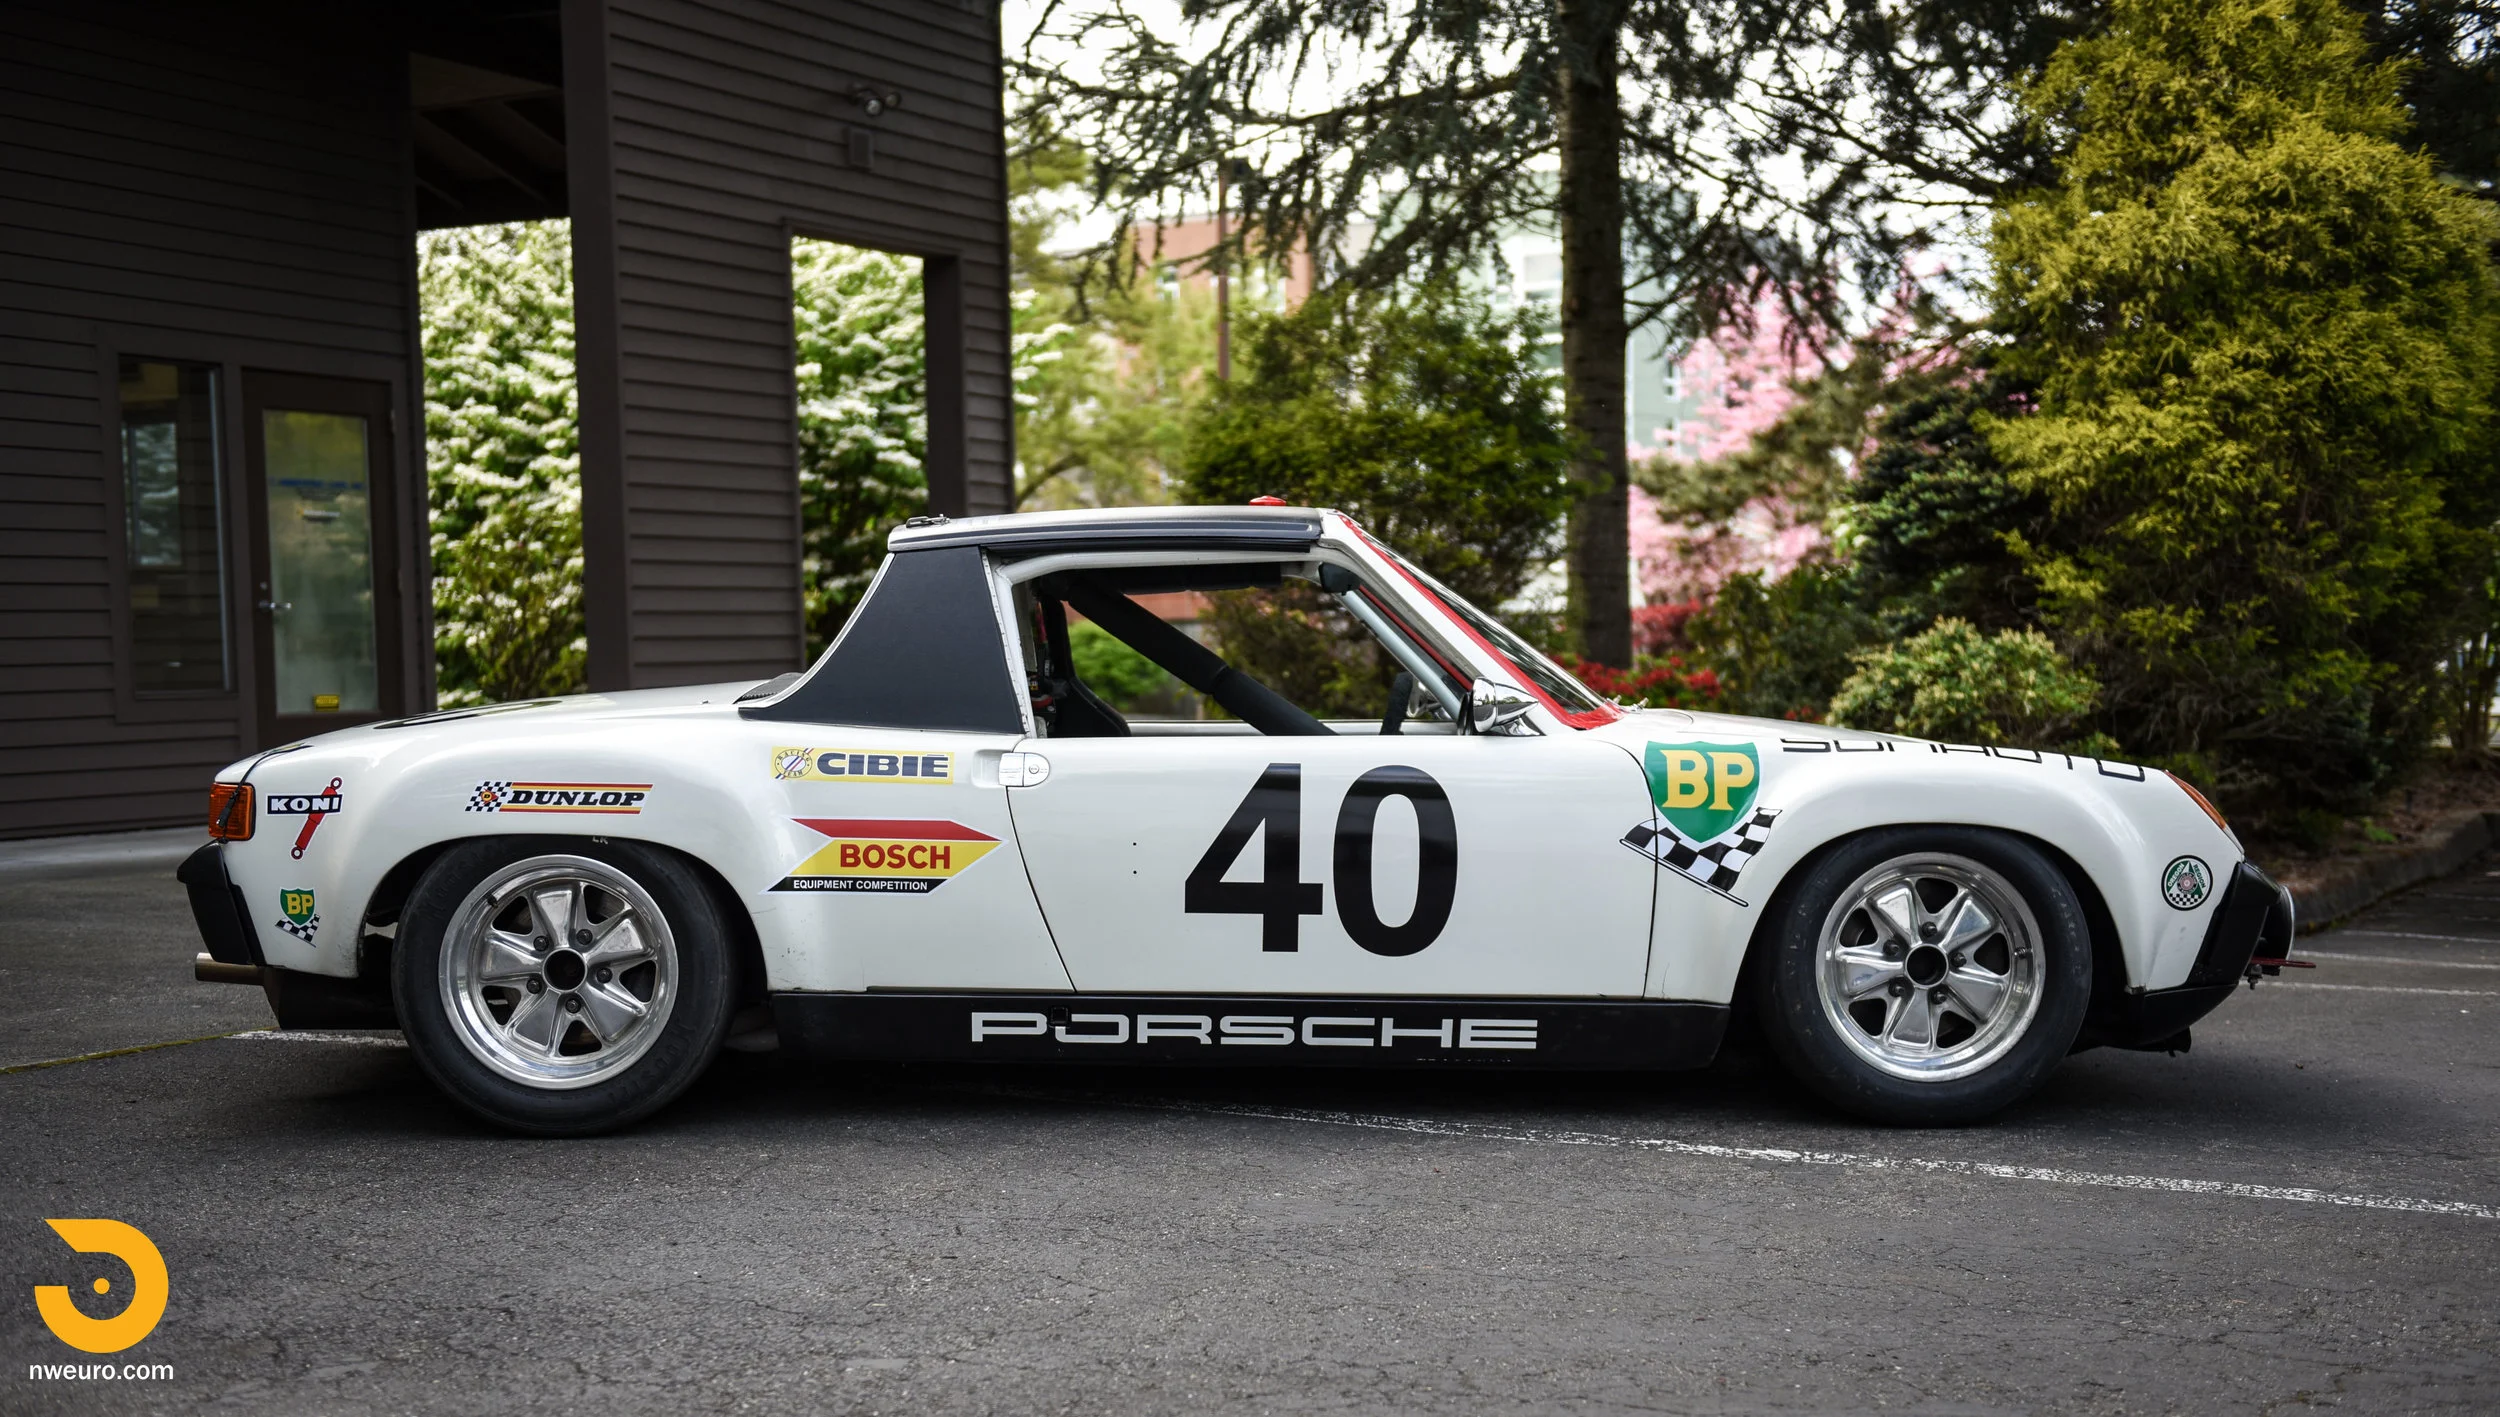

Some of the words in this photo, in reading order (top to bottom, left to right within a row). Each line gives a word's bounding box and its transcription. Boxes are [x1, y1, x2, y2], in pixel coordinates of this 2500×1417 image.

[1660, 749, 1755, 811] BP
[270, 797, 340, 812] KONI
[507, 790, 645, 807] DUNLOP
[840, 843, 950, 870] BOSCH
[1184, 762, 1458, 957] 40
[793, 879, 853, 890] EQUIPMENT
[856, 880, 928, 891] COMPETITION
[2167, 863, 2185, 887] OREGON
[2193, 864, 2206, 888] REGION
[285, 893, 314, 916] BP
[971, 1011, 1538, 1050] PORSCHE
